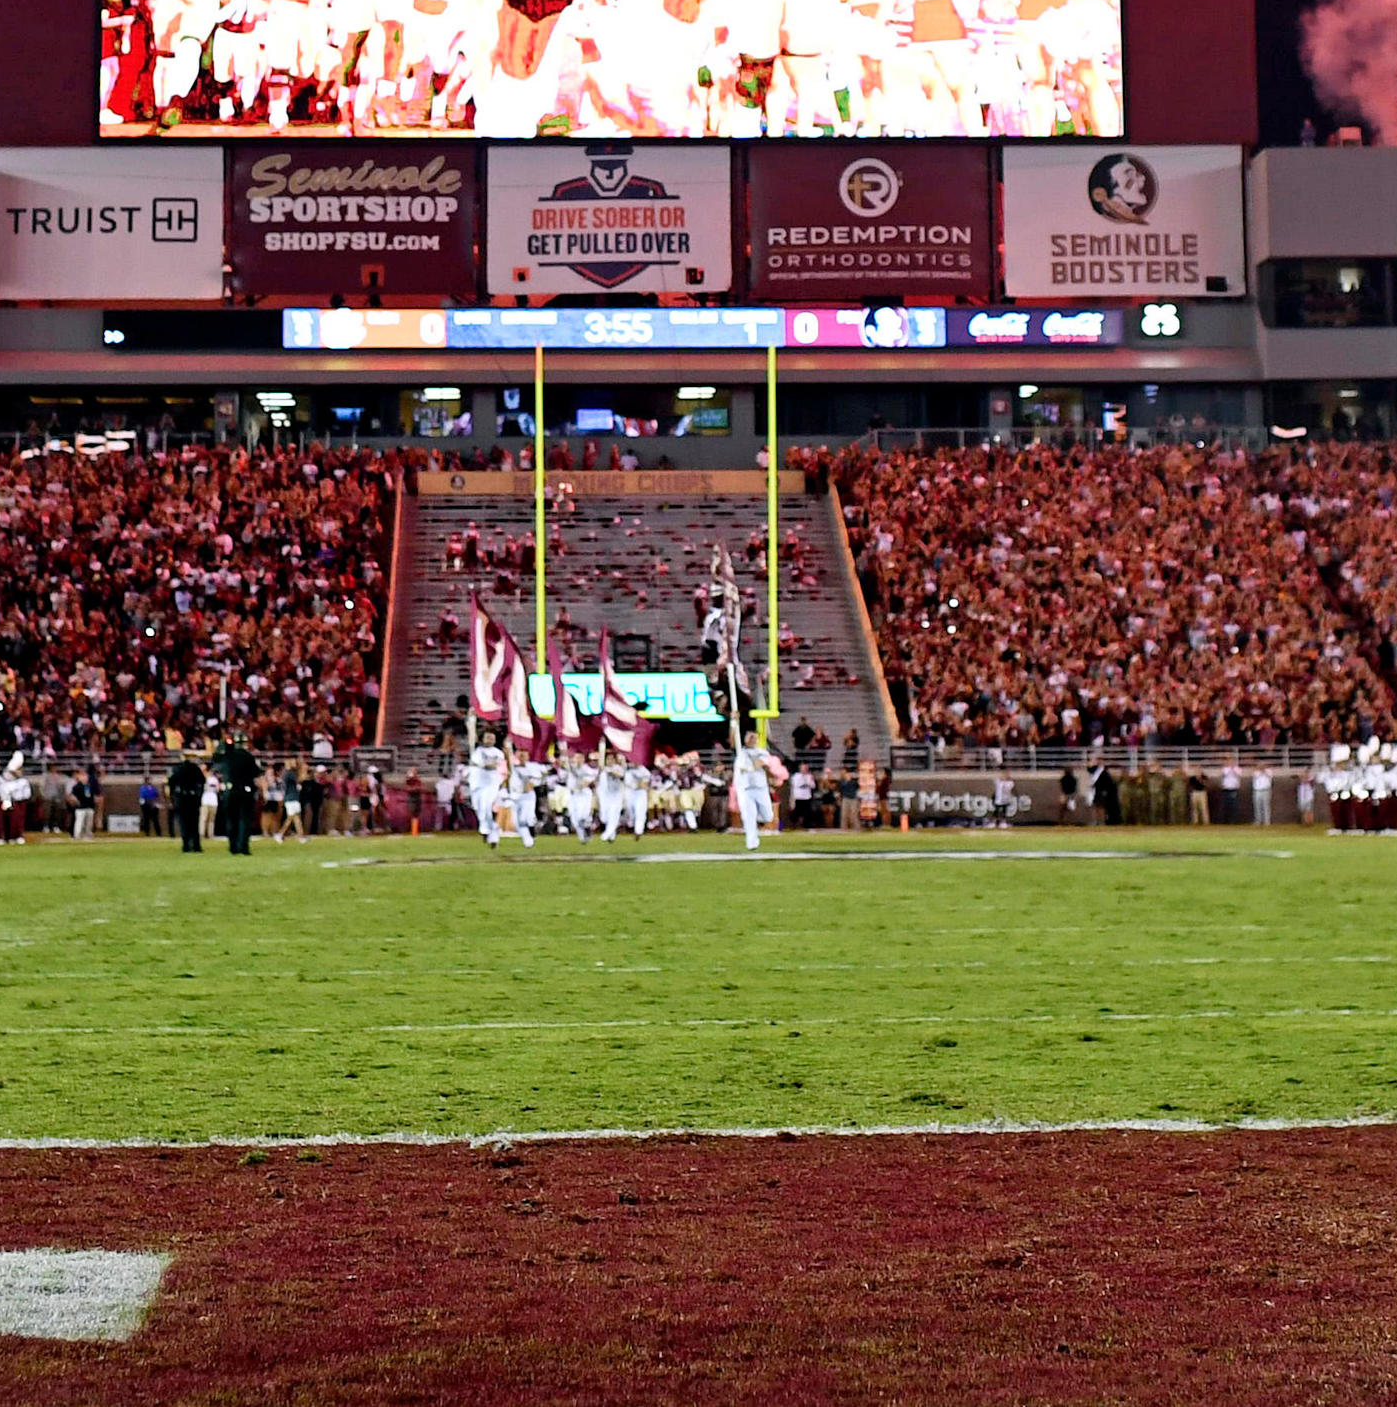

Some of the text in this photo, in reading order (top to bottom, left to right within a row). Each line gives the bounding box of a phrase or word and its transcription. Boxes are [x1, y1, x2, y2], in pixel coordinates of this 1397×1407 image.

[246, 153, 462, 199] Seminole
[6, 207, 141, 235] TRUIST
[249, 196, 458, 223] SPORTSHOP
[532, 206, 686, 230] DRIVE SOBER OR
[264, 232, 440, 251] SHOPFSU.COM
[527, 232, 691, 256] GET PULLED OVER
[767, 225, 971, 245] REDEMPTION
[1050, 234, 1198, 257] SEMINOLE
[768, 253, 972, 268] ORTHODONTICS
[1051, 261, 1200, 284] BOOSTERS
[420, 313, 445, 345] 0
[584, 311, 653, 344] 3:55
[793, 312, 819, 344] 0
